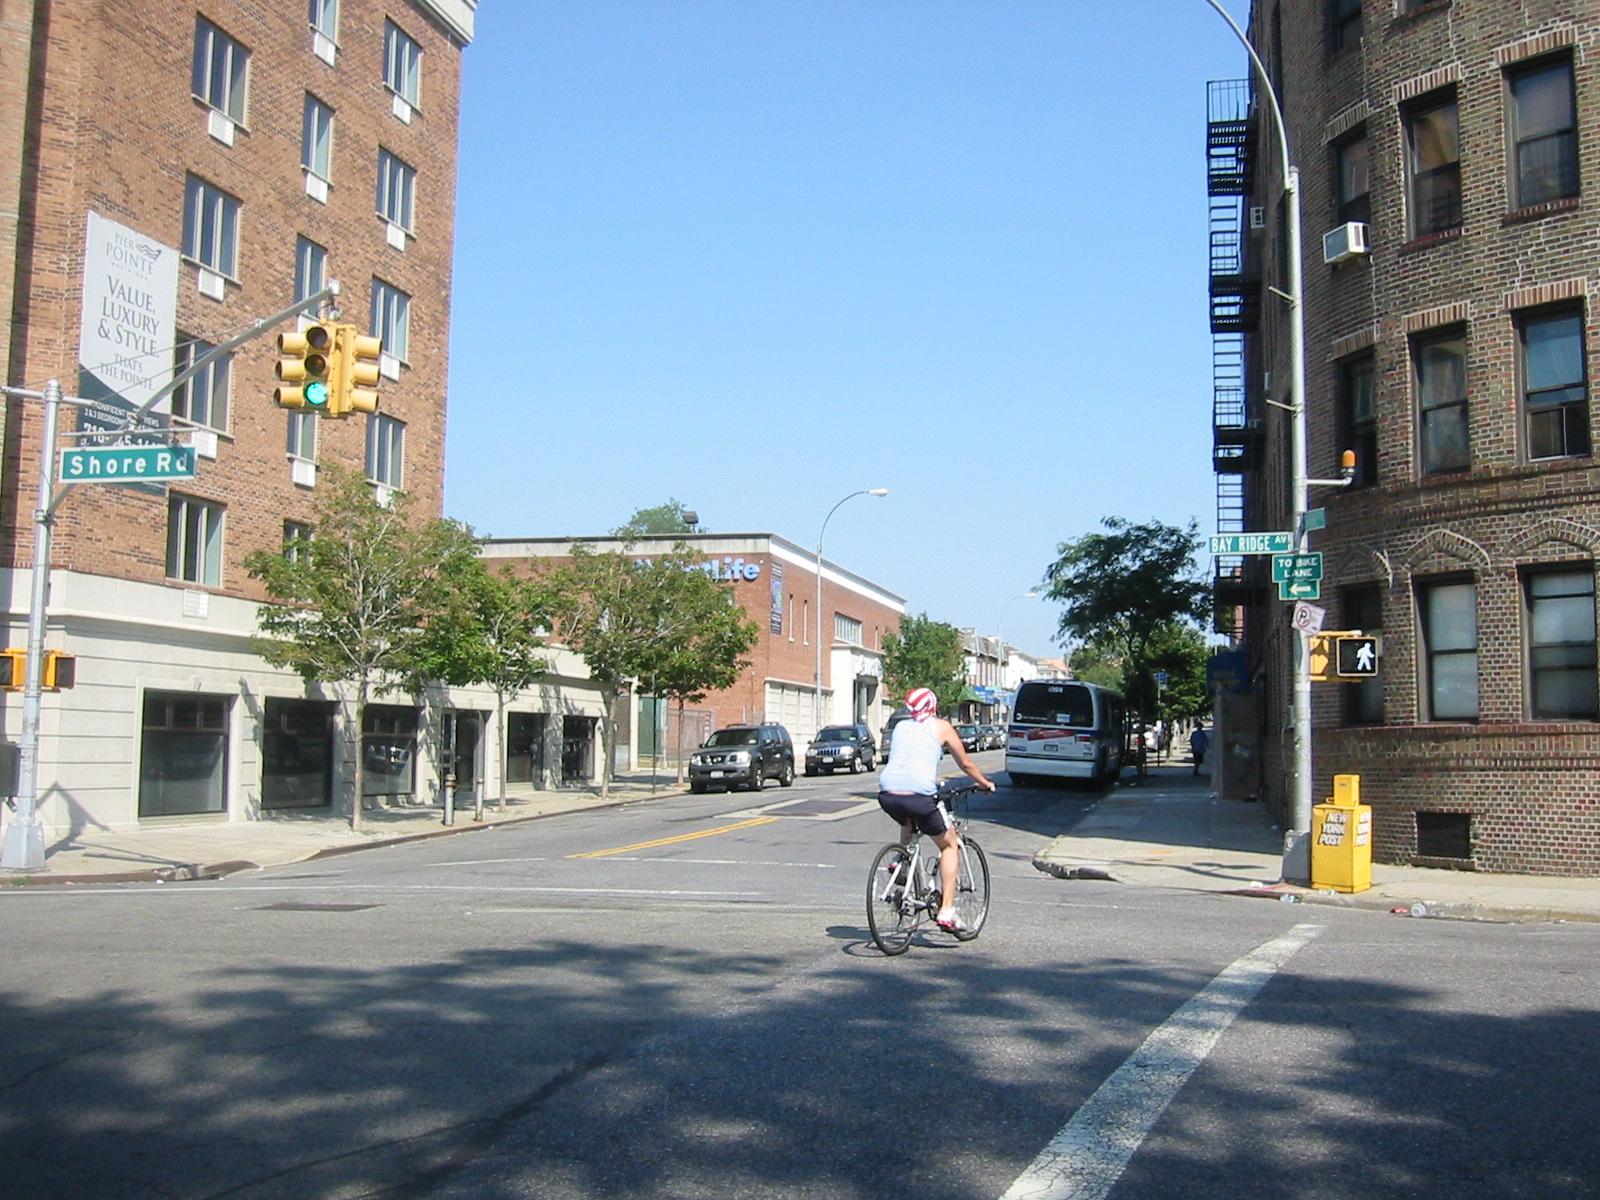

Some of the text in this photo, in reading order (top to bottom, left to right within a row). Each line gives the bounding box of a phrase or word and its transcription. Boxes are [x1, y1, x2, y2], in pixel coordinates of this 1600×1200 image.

[115, 233, 134, 251] PIER
[106, 242, 153, 275] POINTE
[107, 274, 156, 315] VALUE,
[102, 296, 160, 335] LUXURY
[98, 318, 111, 340] &
[99, 362, 118, 378] THE
[70, 452, 188, 475] Shore Rd
[1212, 537, 1232, 553] BAY
[1238, 536, 1271, 552] RIDGE
[1278, 557, 1318, 568] TO BIKE
[1283, 568, 1313, 578] LANE
[1327, 812, 1348, 823] NEW
[1322, 823, 1346, 834] YORK
[1319, 834, 1343, 846] POST
